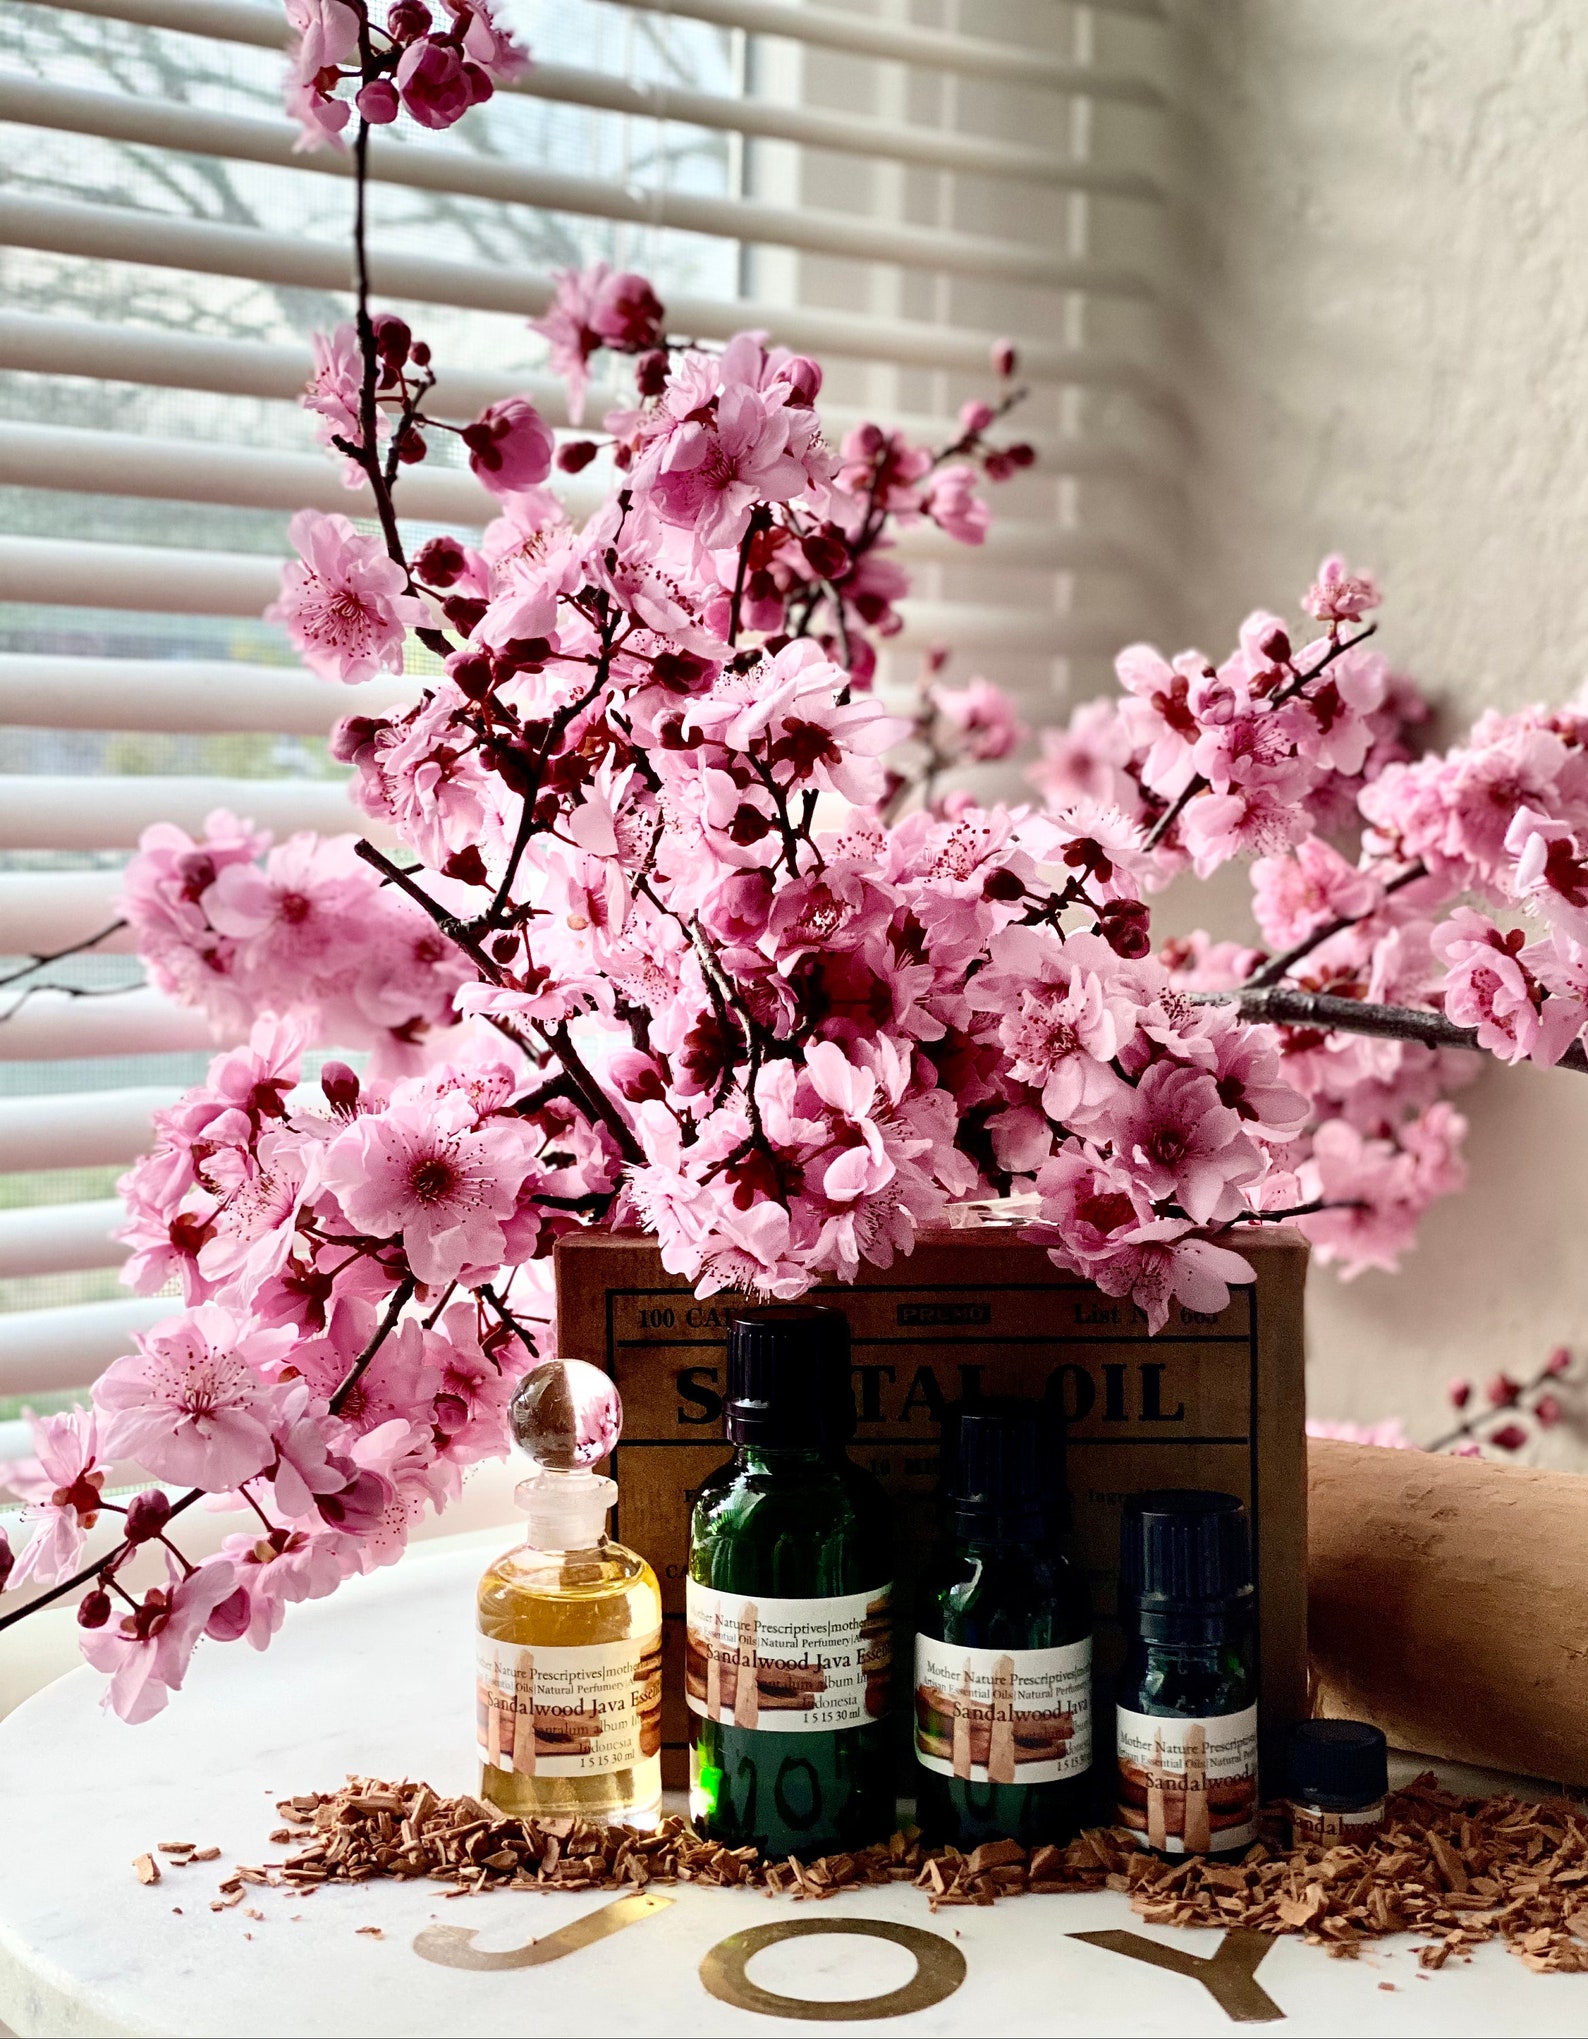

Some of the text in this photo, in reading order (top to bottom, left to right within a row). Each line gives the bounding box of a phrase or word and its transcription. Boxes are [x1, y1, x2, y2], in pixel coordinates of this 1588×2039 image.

[640, 1308, 674, 1328] 100
[1073, 1303, 1120, 1324] List
[676, 1363, 1185, 1424] STAL OIL
[715, 1613, 751, 1631] Nature
[706, 1643, 809, 1671] Sandalwood
[813, 1653, 851, 1673] Java
[494, 1661, 528, 1679] Nature
[926, 1660, 961, 1682] Mother
[965, 1671, 1007, 1686] Nature
[817, 1675, 854, 1689] album
[949, 1683, 991, 1699] Essential
[487, 1690, 585, 1717] Sandalwood
[589, 1699, 625, 1718] Java
[952, 1698, 1088, 1722] Sandalwood Java
[812, 1712, 818, 1723] 5
[822, 1711, 833, 1722] 15
[836, 1709, 847, 1720] 30
[849, 1707, 861, 1718] ml
[593, 1717, 628, 1734] album
[1120, 1731, 1152, 1751] Mother
[1156, 1740, 1201, 1755] Nature
[588, 1757, 594, 1768] 5
[598, 1756, 609, 1767] 15
[611, 1754, 622, 1764] 30
[624, 1750, 635, 1761] ml
[1145, 1763, 1250, 1792] Sandalwood
